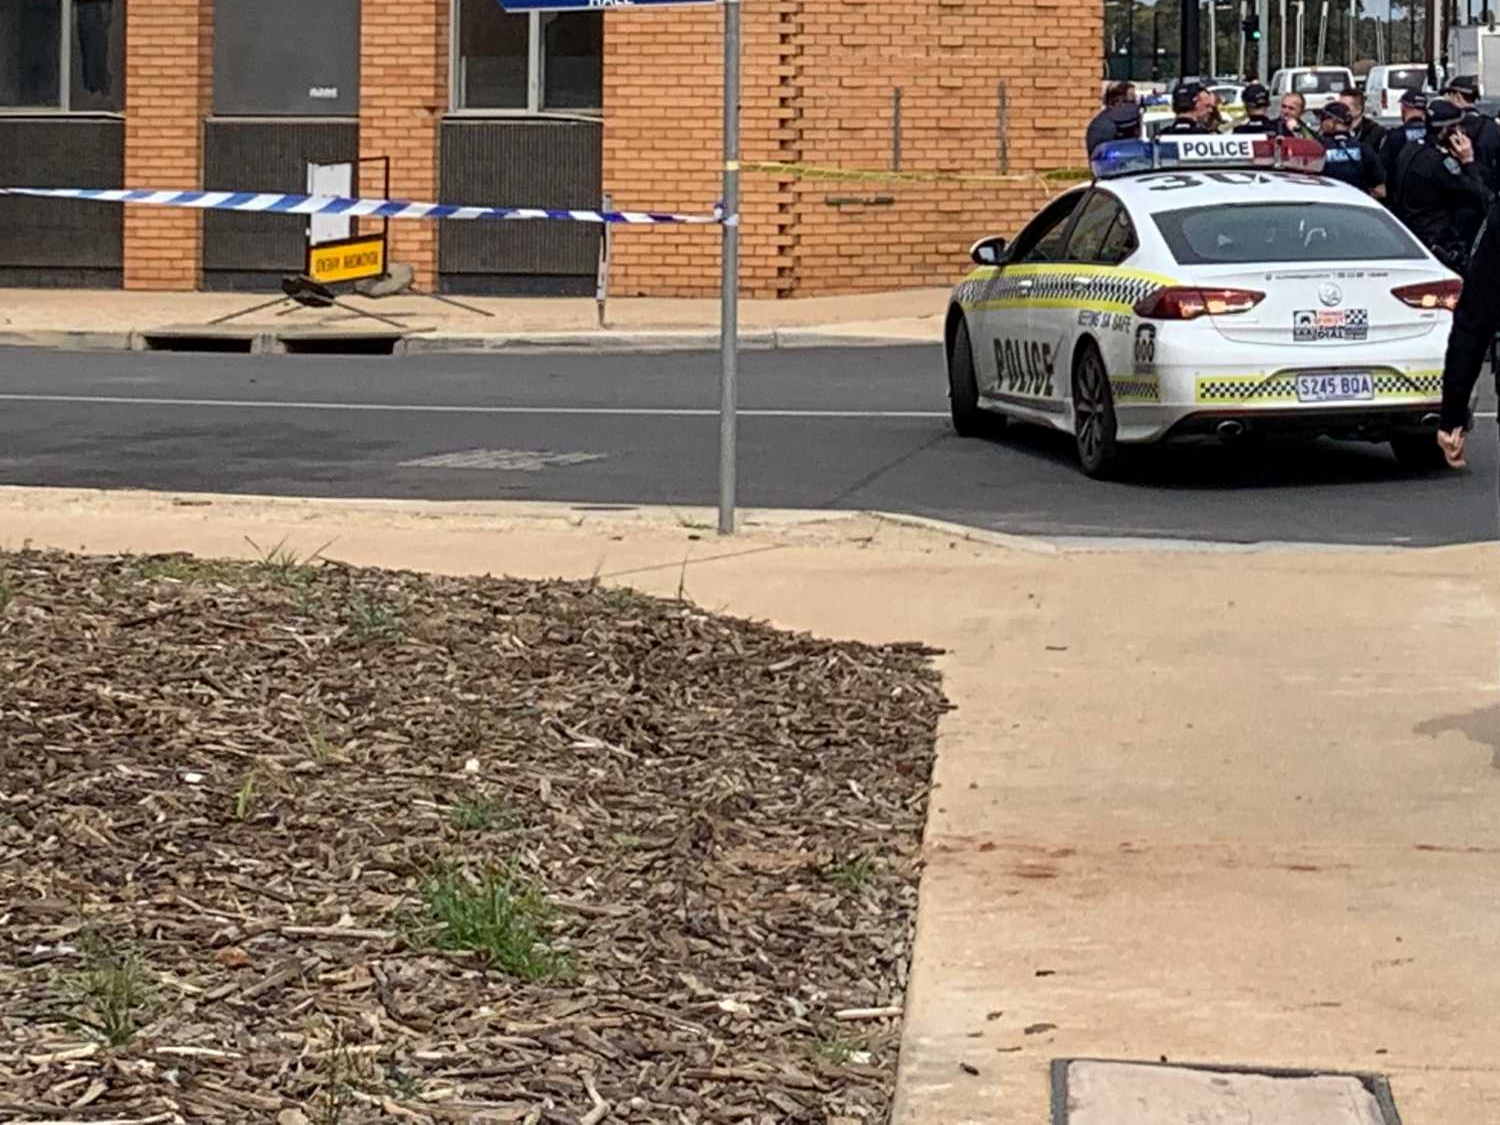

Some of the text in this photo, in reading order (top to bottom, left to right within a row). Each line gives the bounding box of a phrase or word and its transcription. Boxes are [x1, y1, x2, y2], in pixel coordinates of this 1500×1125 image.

[1183, 141, 1250, 157] POLICE
[993, 338, 1055, 396] POLICE
[1300, 378, 1336, 395] S245
